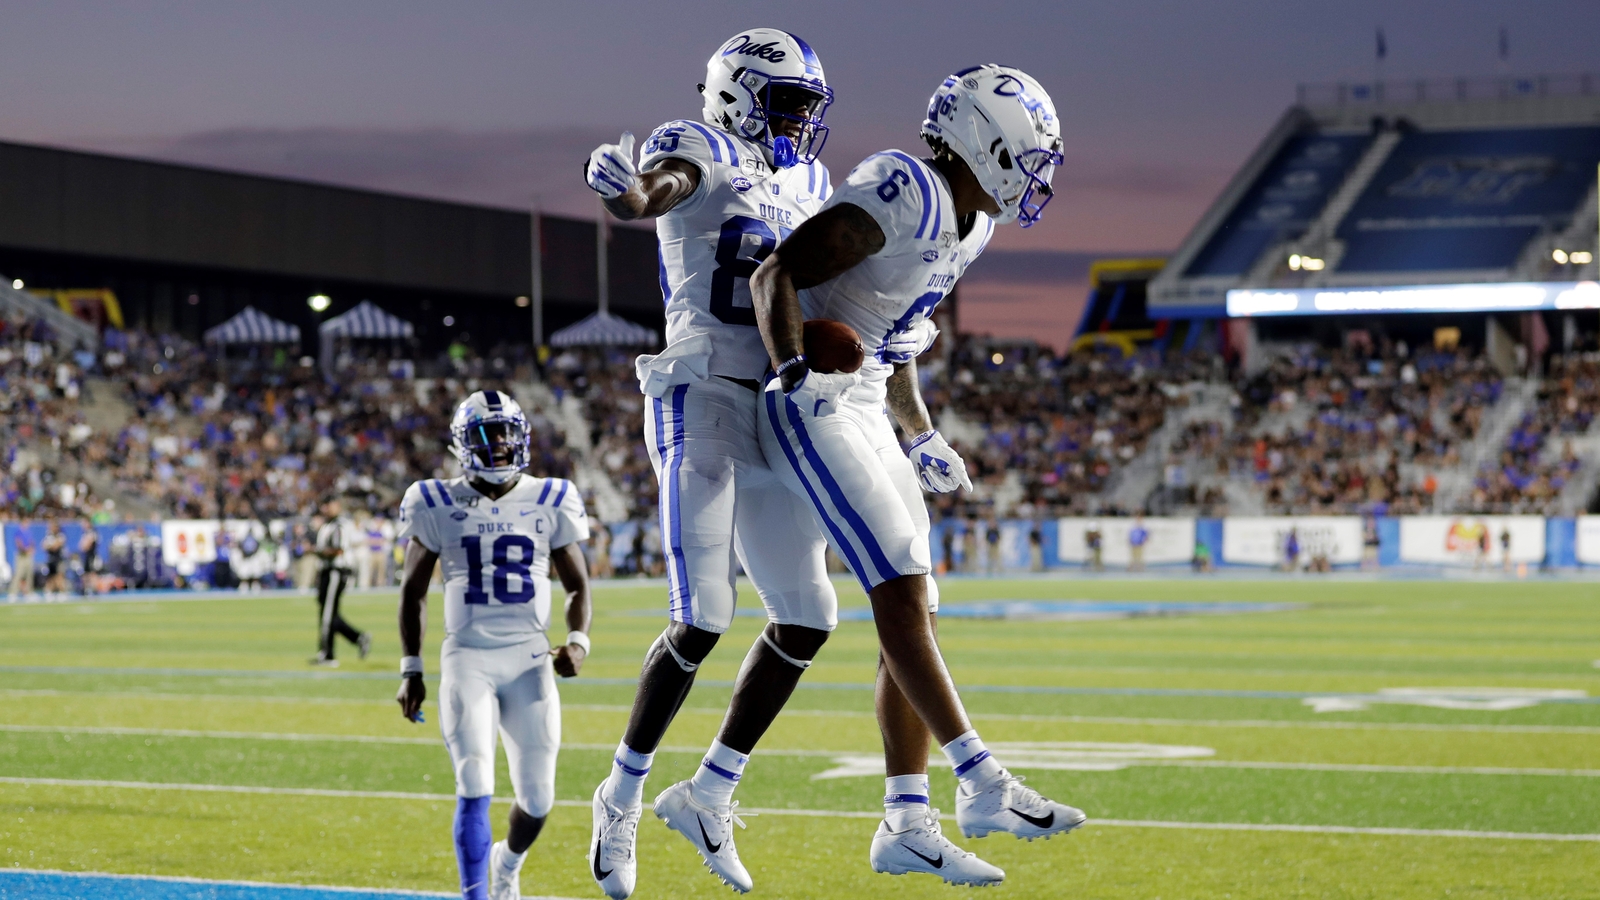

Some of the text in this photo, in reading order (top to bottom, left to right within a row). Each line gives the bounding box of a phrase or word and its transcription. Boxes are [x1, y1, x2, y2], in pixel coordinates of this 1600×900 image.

[722, 35, 786, 63] Duke
[645, 127, 686, 154] 85
[877, 169, 909, 202] 6
[759, 203, 792, 225] DUKE
[710, 215, 793, 327] 8
[927, 273, 954, 288] DUKE
[478, 522, 514, 533] DUKE
[536, 518, 543, 533] C
[461, 535, 535, 604] 18
